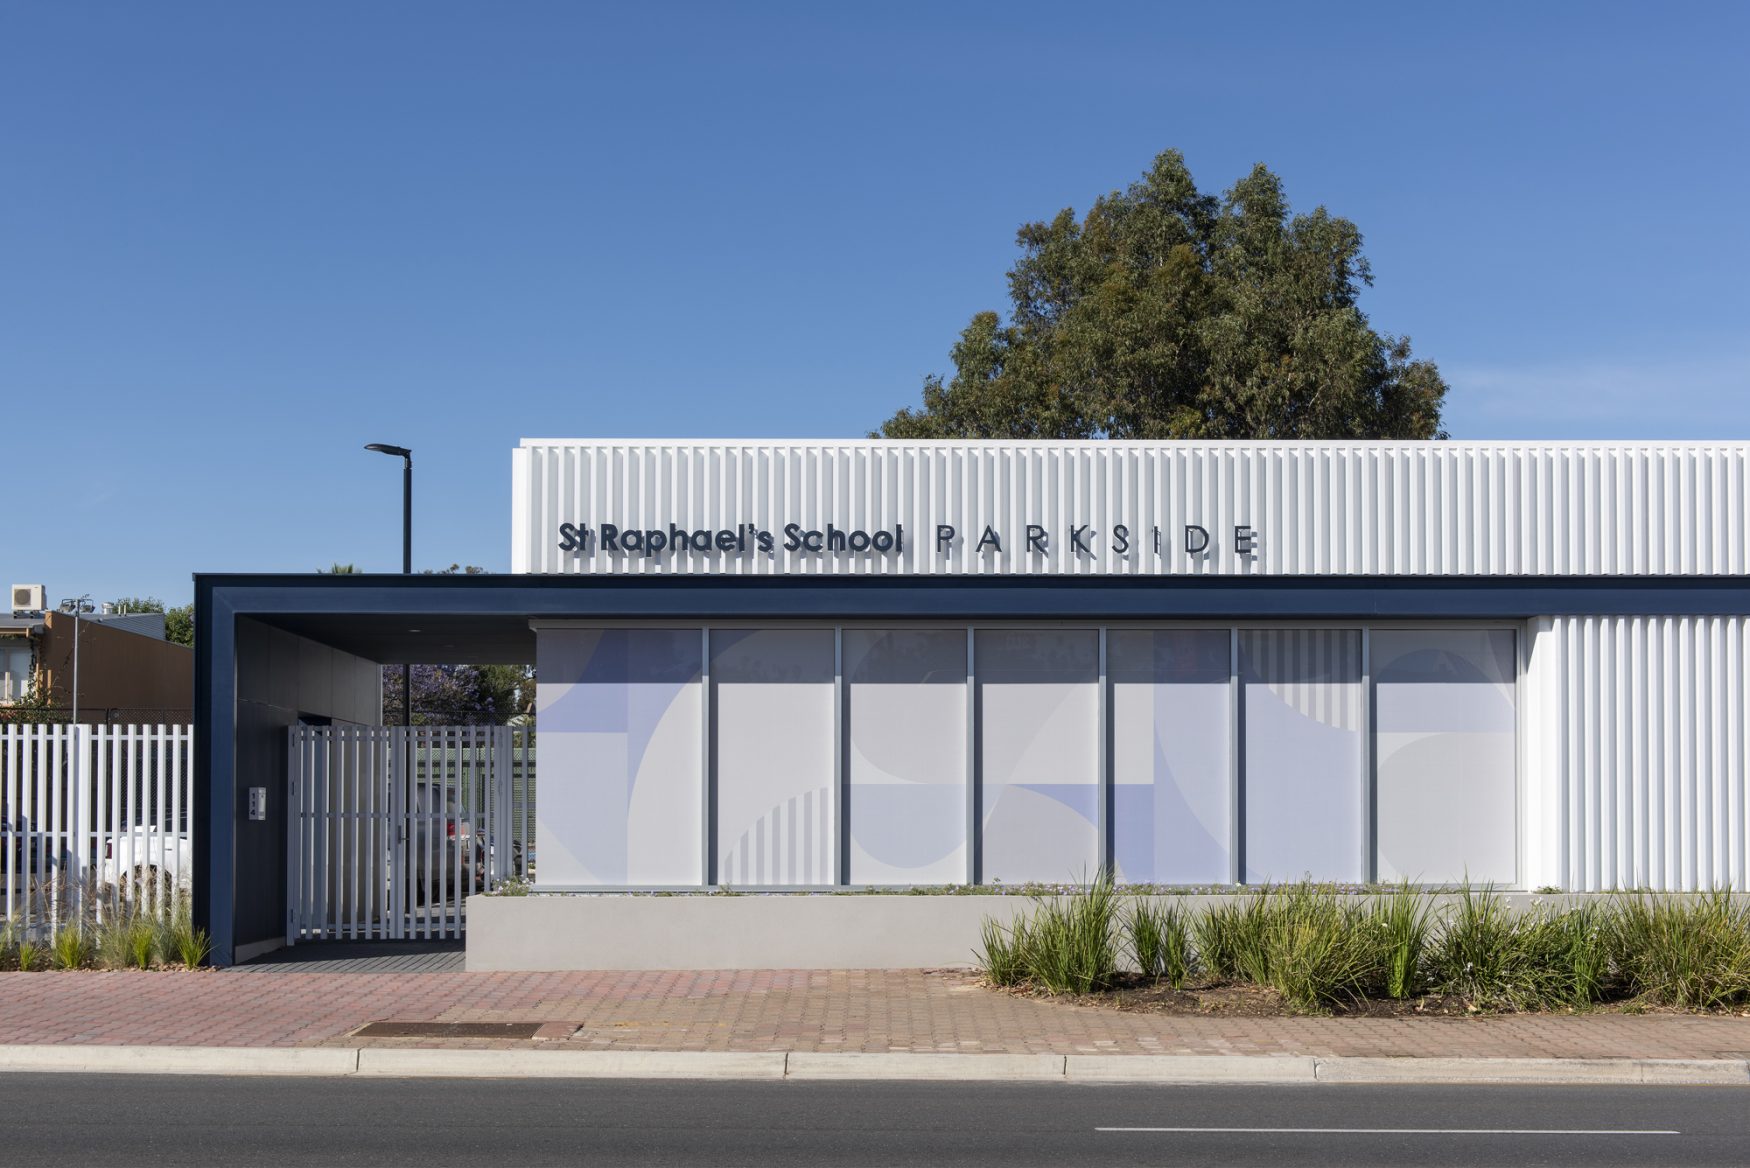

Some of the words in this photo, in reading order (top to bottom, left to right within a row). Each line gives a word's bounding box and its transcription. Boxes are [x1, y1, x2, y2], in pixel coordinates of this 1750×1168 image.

[558, 522, 589, 551] St
[600, 522, 774, 557] Raphael's
[784, 522, 904, 552] School
[937, 524, 1252, 554] PARKSIDE
